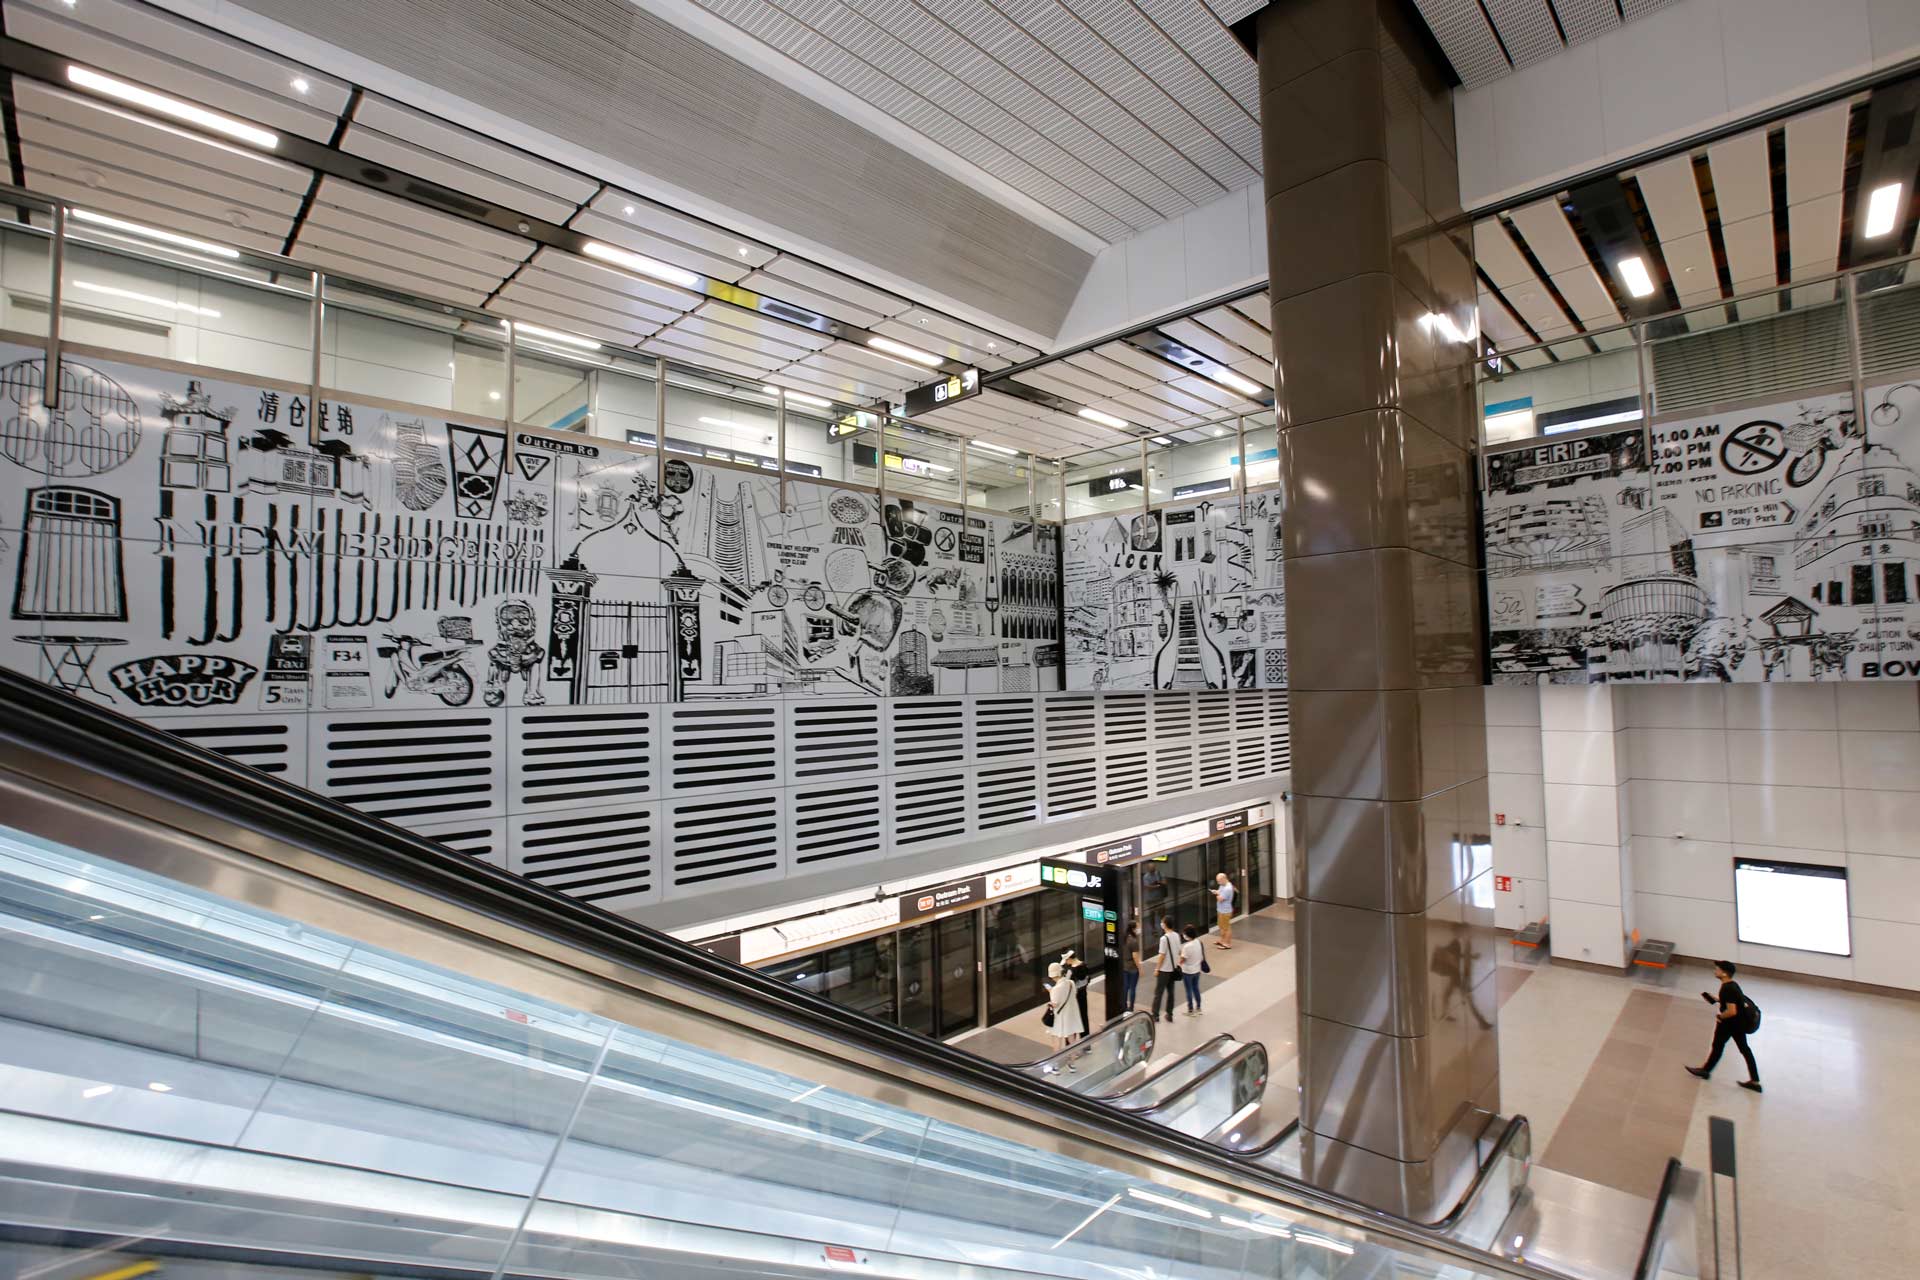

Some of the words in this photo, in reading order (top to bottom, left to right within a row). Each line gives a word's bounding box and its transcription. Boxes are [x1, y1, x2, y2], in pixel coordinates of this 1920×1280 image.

[1693, 424, 1720, 439] AM
[523, 435, 573, 453] Outram
[578, 446, 593, 457] Rd
[1535, 440, 1588, 465] ERP
[1687, 441, 1711, 455] PM
[1653, 461, 1683, 475] 7.00
[1688, 457, 1712, 470] PM
[1695, 488, 1715, 503] NO
[1721, 478, 1782, 501] PARKING
[1727, 506, 1758, 516] Pearl's
[1763, 503, 1778, 511] Hill
[1731, 517, 1751, 527] City
[1756, 514, 1777, 522] Park
[1888, 641, 1913, 651] TURN
[274, 658, 305, 669] Taxi
[333, 650, 361, 662] F34
[113, 656, 257, 689] HAPPY
[136, 677, 236, 705] HOUR
[265, 686, 281, 704] 5
